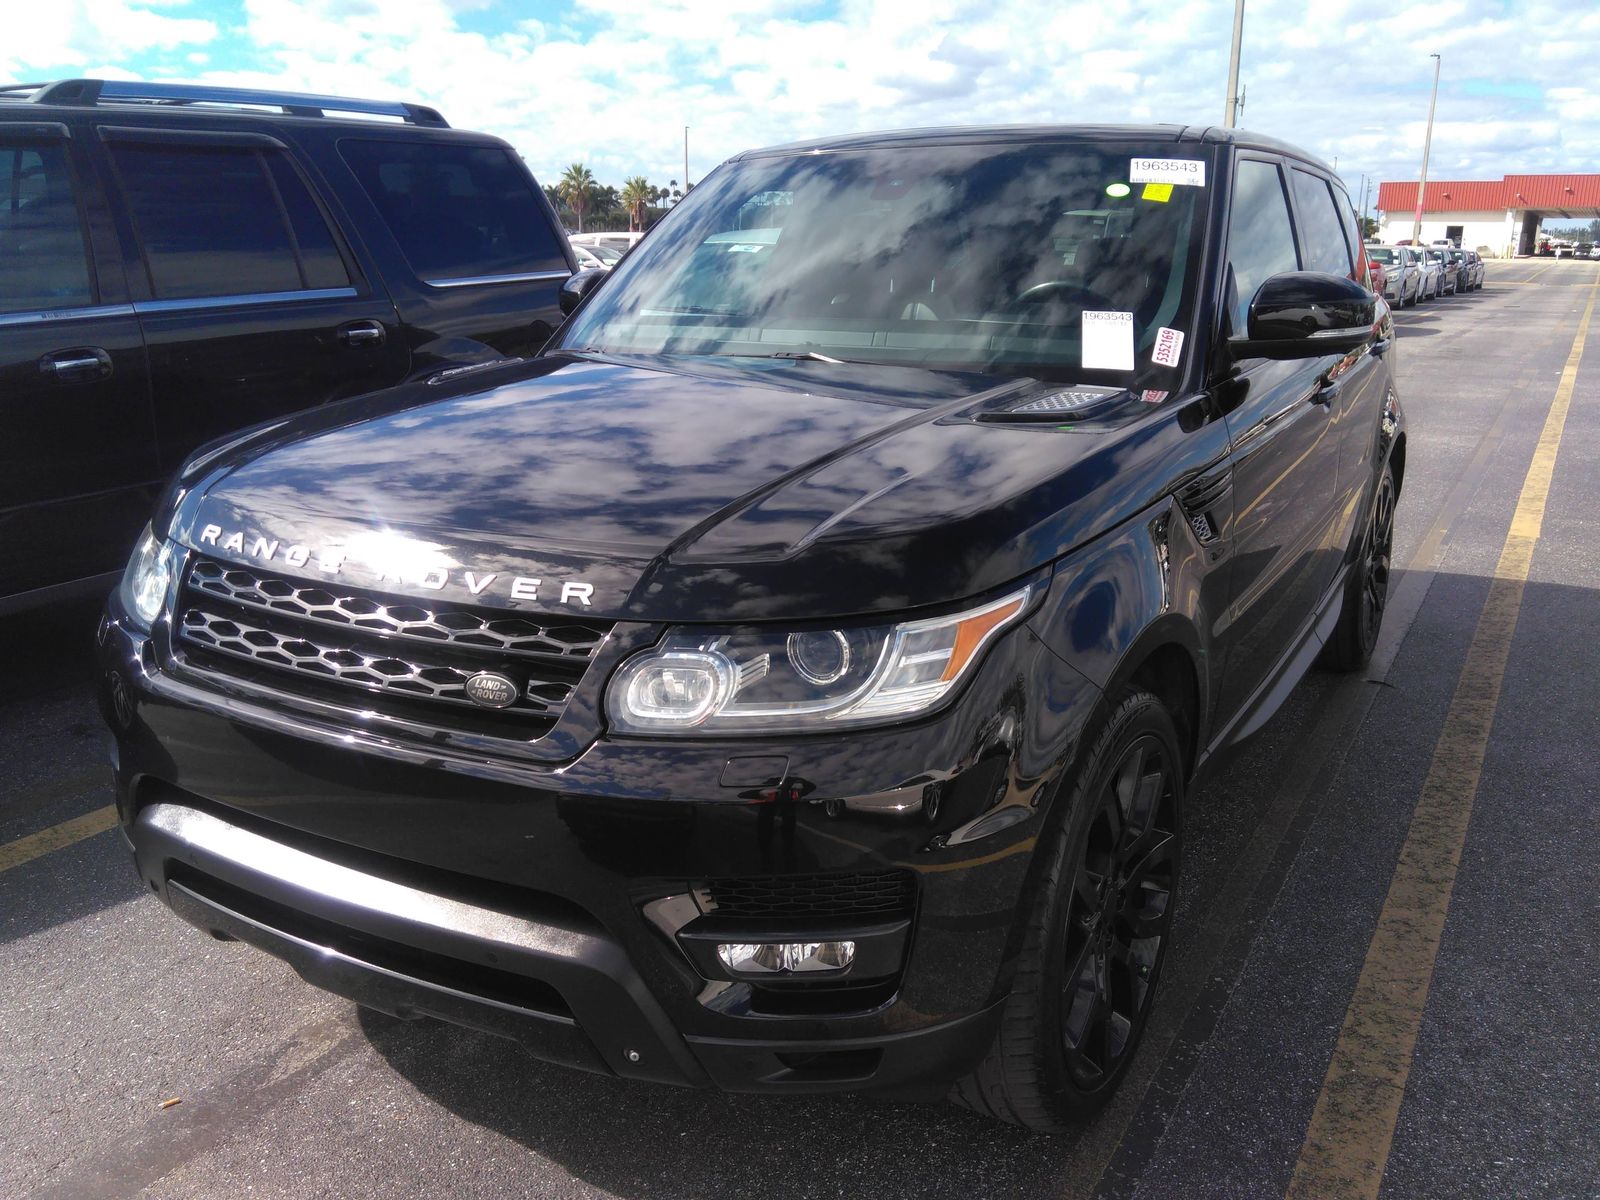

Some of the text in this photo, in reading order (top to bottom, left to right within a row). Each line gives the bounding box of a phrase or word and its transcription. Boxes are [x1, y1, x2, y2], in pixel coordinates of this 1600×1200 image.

[1133, 160, 1198, 173] 1963543
[1083, 311, 1133, 322] 1963543
[1156, 329, 1175, 364] 5352169
[474, 678, 501, 691] LAND
[475, 688, 508, 701] ROVER
